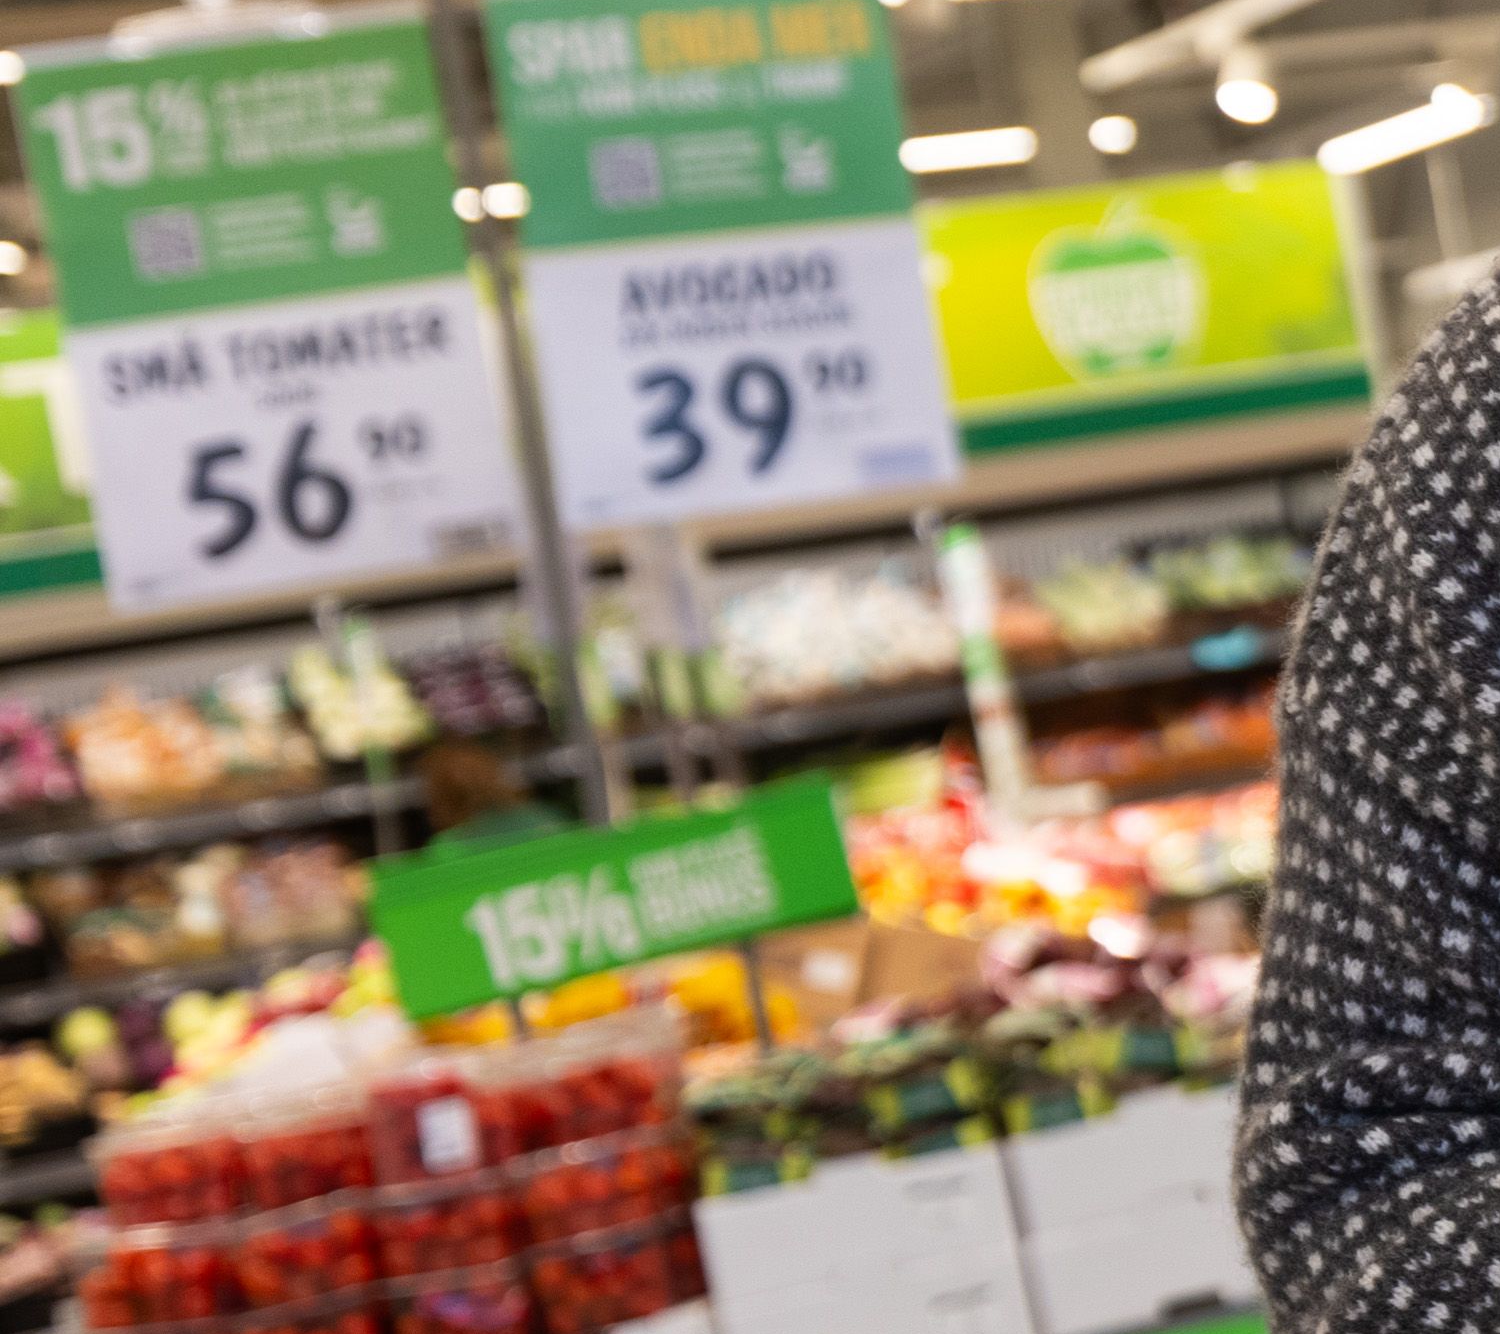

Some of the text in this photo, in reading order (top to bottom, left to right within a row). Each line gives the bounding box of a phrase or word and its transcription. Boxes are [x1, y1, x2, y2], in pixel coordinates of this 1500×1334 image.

[619, 250, 842, 320] AVOCADO
[104, 304, 452, 404] SMÅ TOMATER
[632, 346, 870, 490] 39 90
[186, 414, 427, 560] 56 90
[464, 860, 641, 990] 15%
